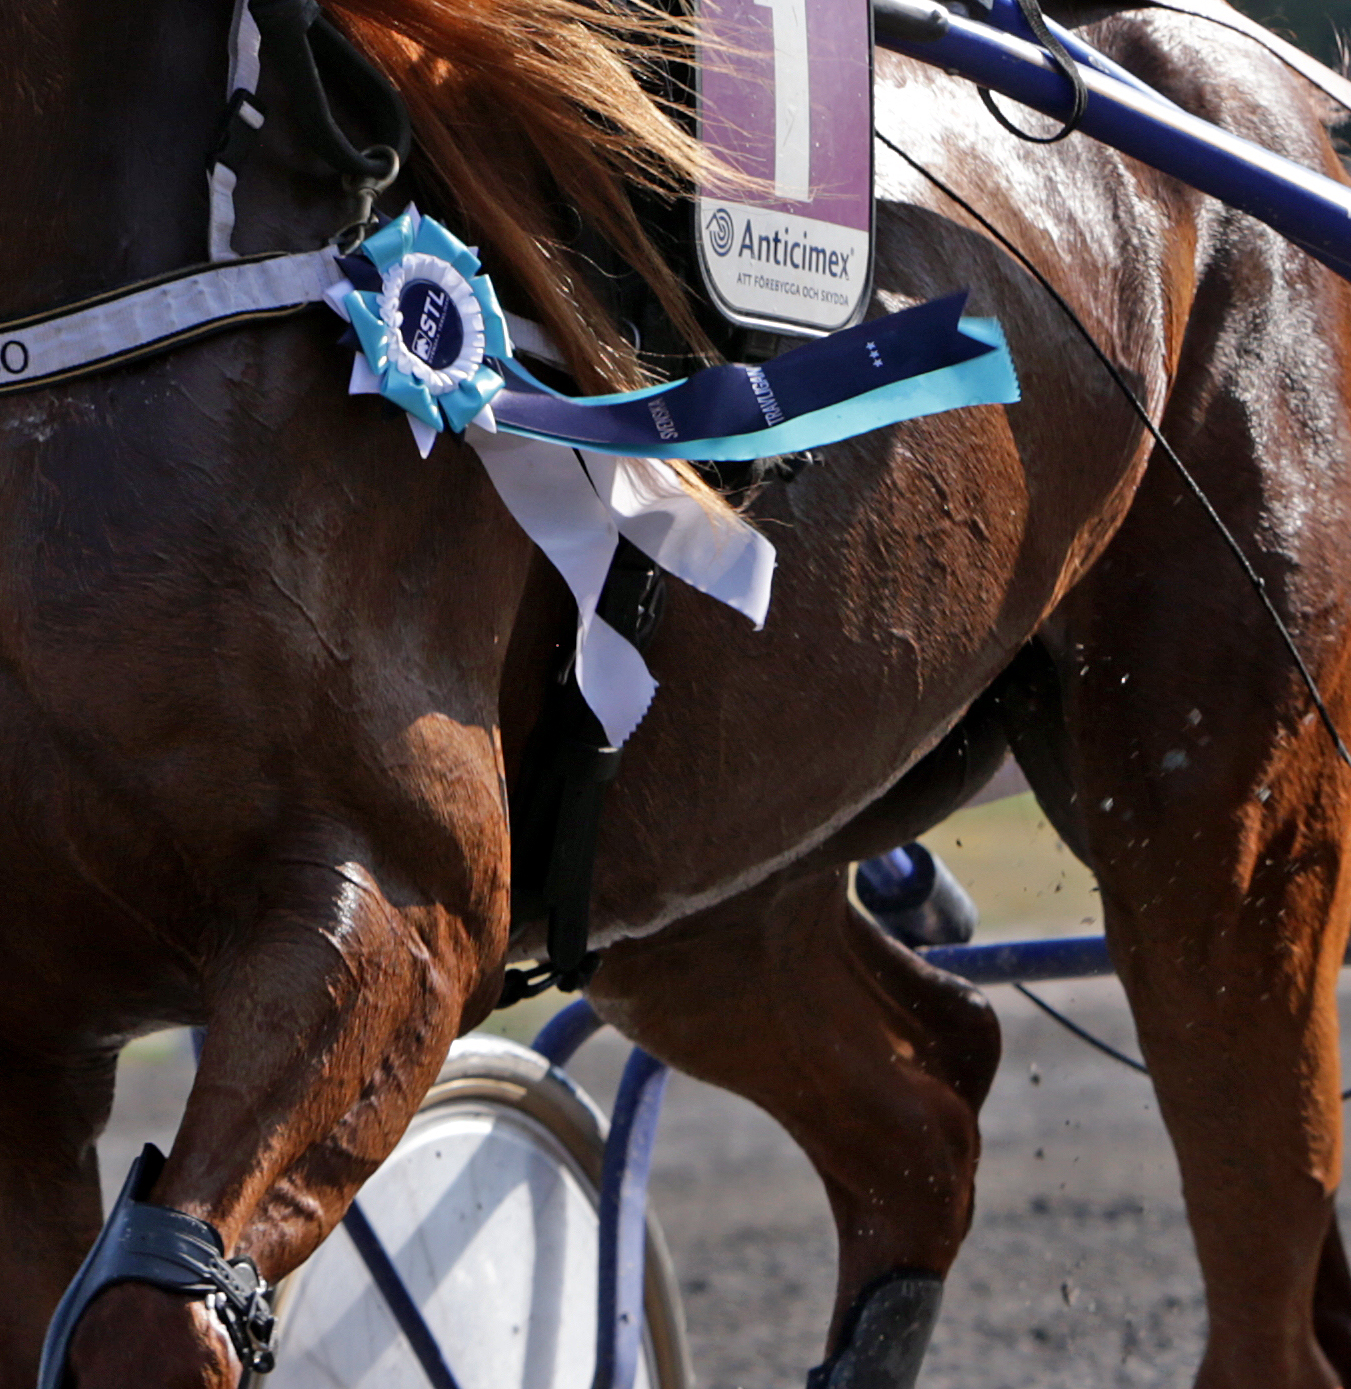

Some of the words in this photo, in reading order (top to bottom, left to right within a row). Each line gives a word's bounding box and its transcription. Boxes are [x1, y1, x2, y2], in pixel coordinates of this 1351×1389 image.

[738, 218, 849, 280] Anticimex
[737, 272, 752, 285] ATT
[754, 275, 799, 296] FÖREBYGGA
[802, 286, 819, 301] OCH
[821, 291, 849, 306] SKYDDA
[420, 290, 444, 338] STL
[648, 397, 678, 440] SVENSKA
[746, 366, 784, 426] TRAVLIGAN
